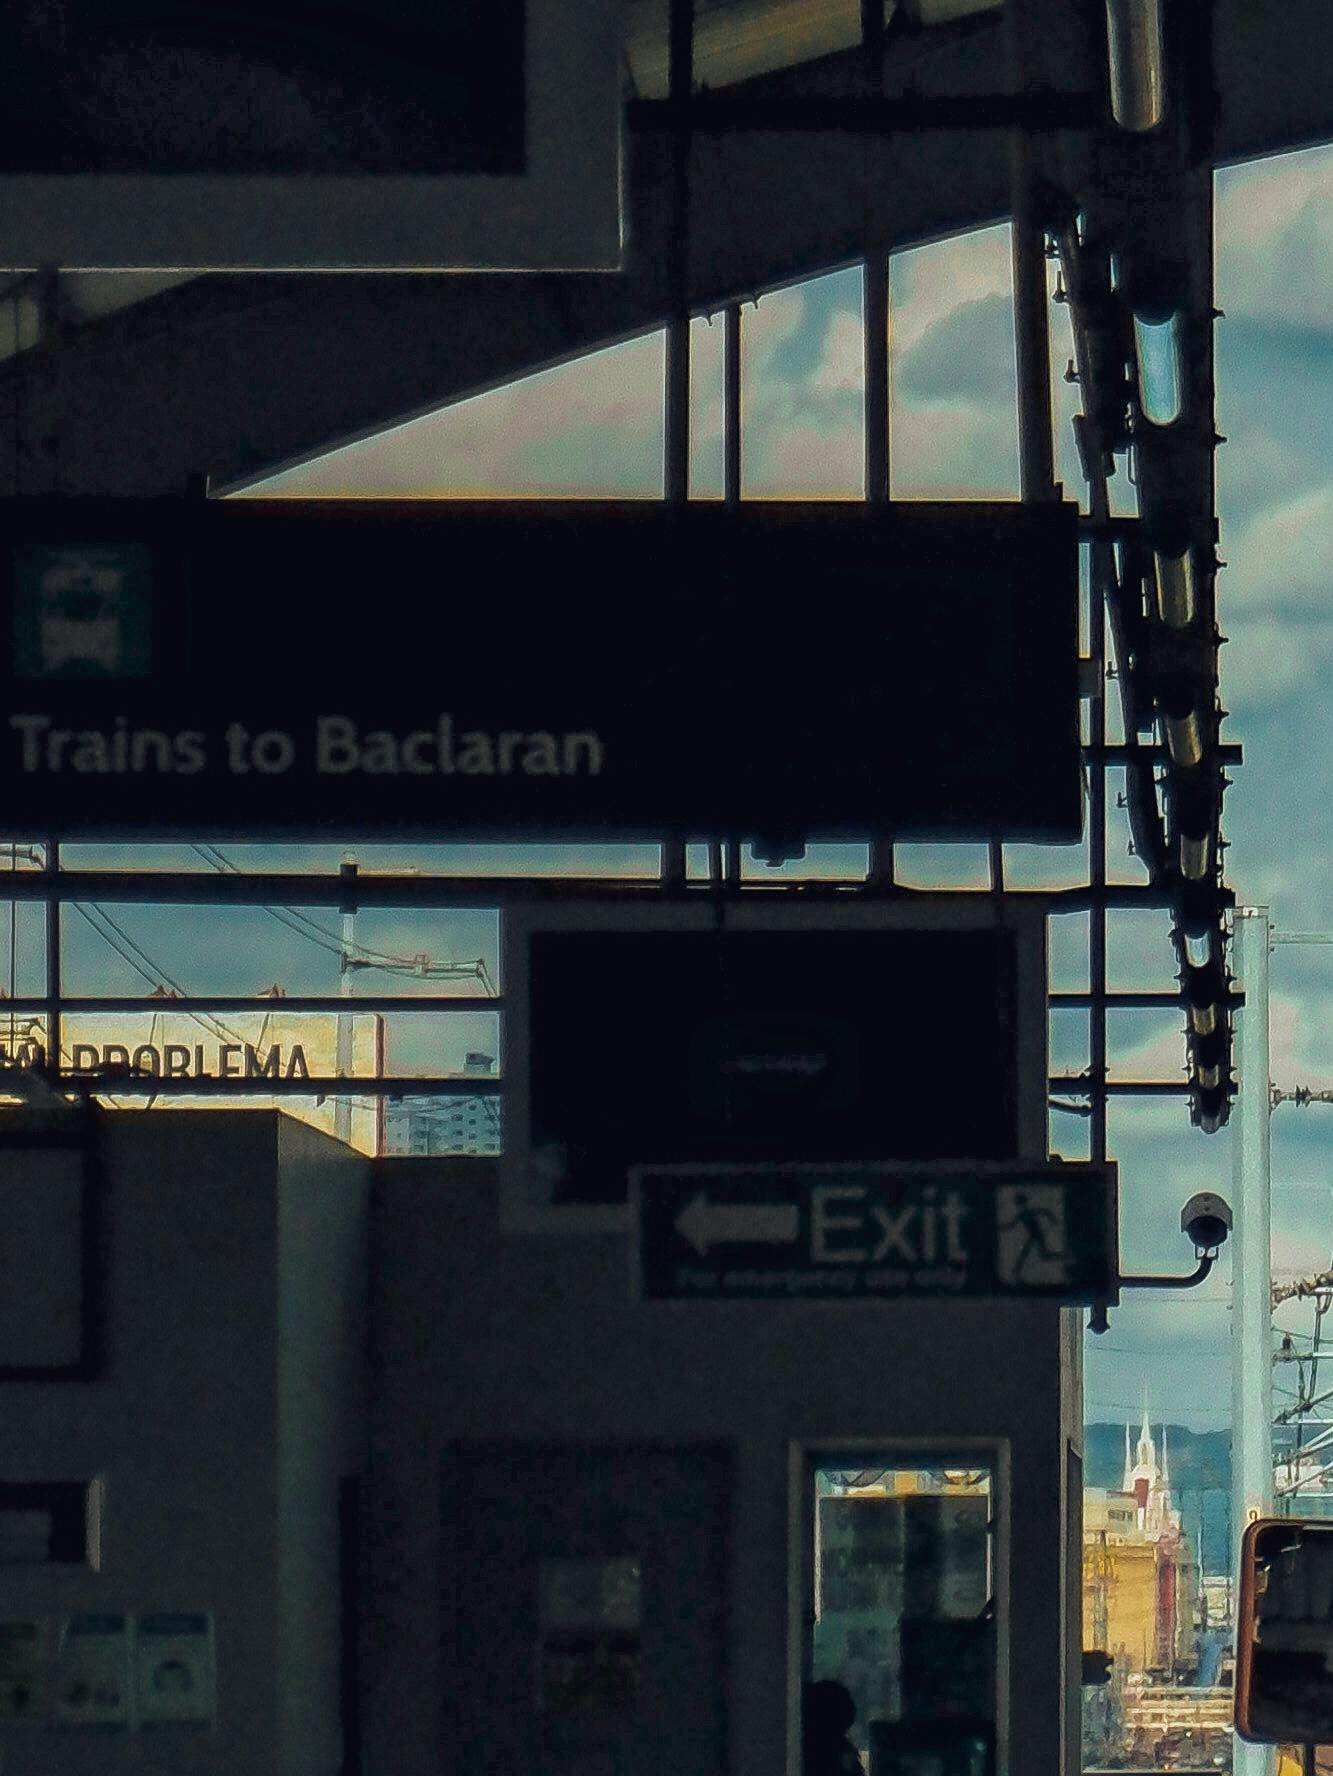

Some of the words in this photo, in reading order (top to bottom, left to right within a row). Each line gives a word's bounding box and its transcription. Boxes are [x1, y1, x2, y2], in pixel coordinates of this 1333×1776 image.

[8, 712, 206, 774] Trains
[225, 720, 296, 774] to
[315, 712, 606, 775] Baclaran
[809, 1184, 970, 1264] Exit
